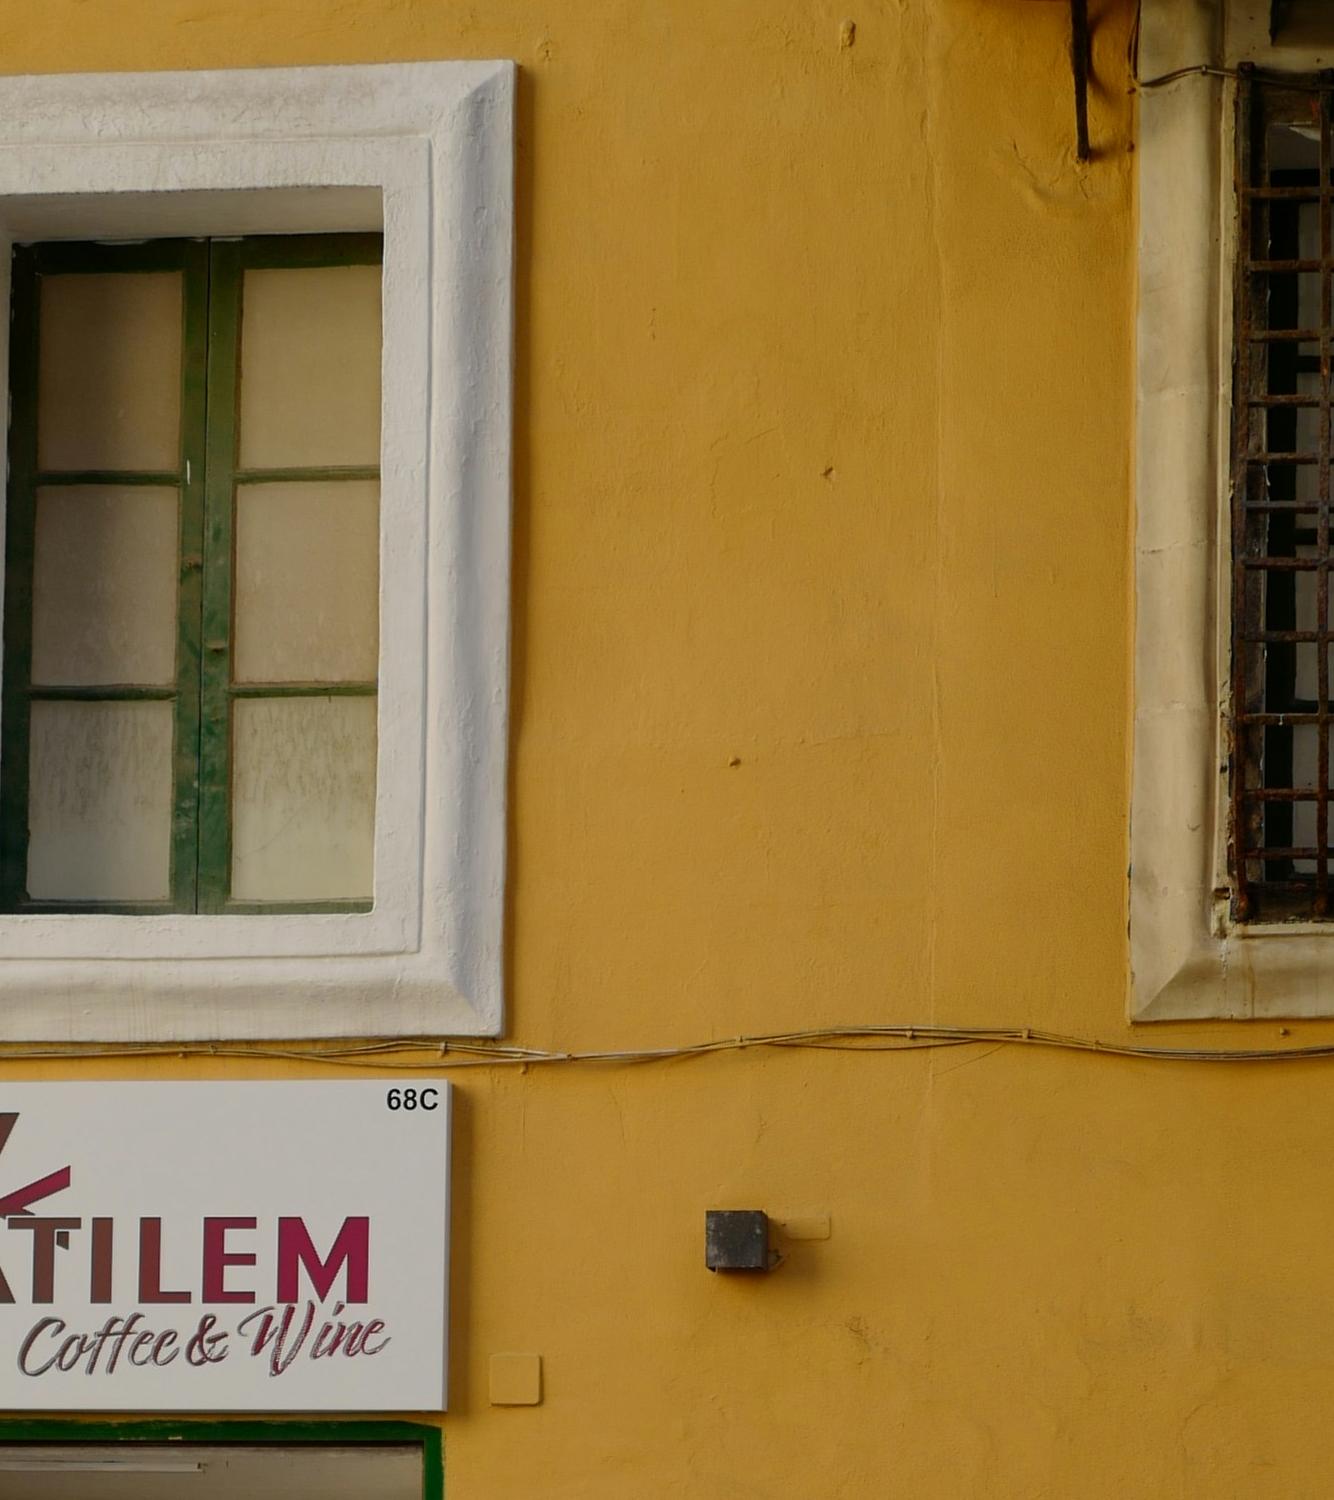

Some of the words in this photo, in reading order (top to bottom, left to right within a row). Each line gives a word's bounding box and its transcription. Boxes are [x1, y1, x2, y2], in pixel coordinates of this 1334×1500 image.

[386, 1088, 439, 1111] 68C
[17, 1312, 180, 1377] Coffee
[185, 1314, 230, 1367] &
[237, 1301, 391, 1378] Wine
